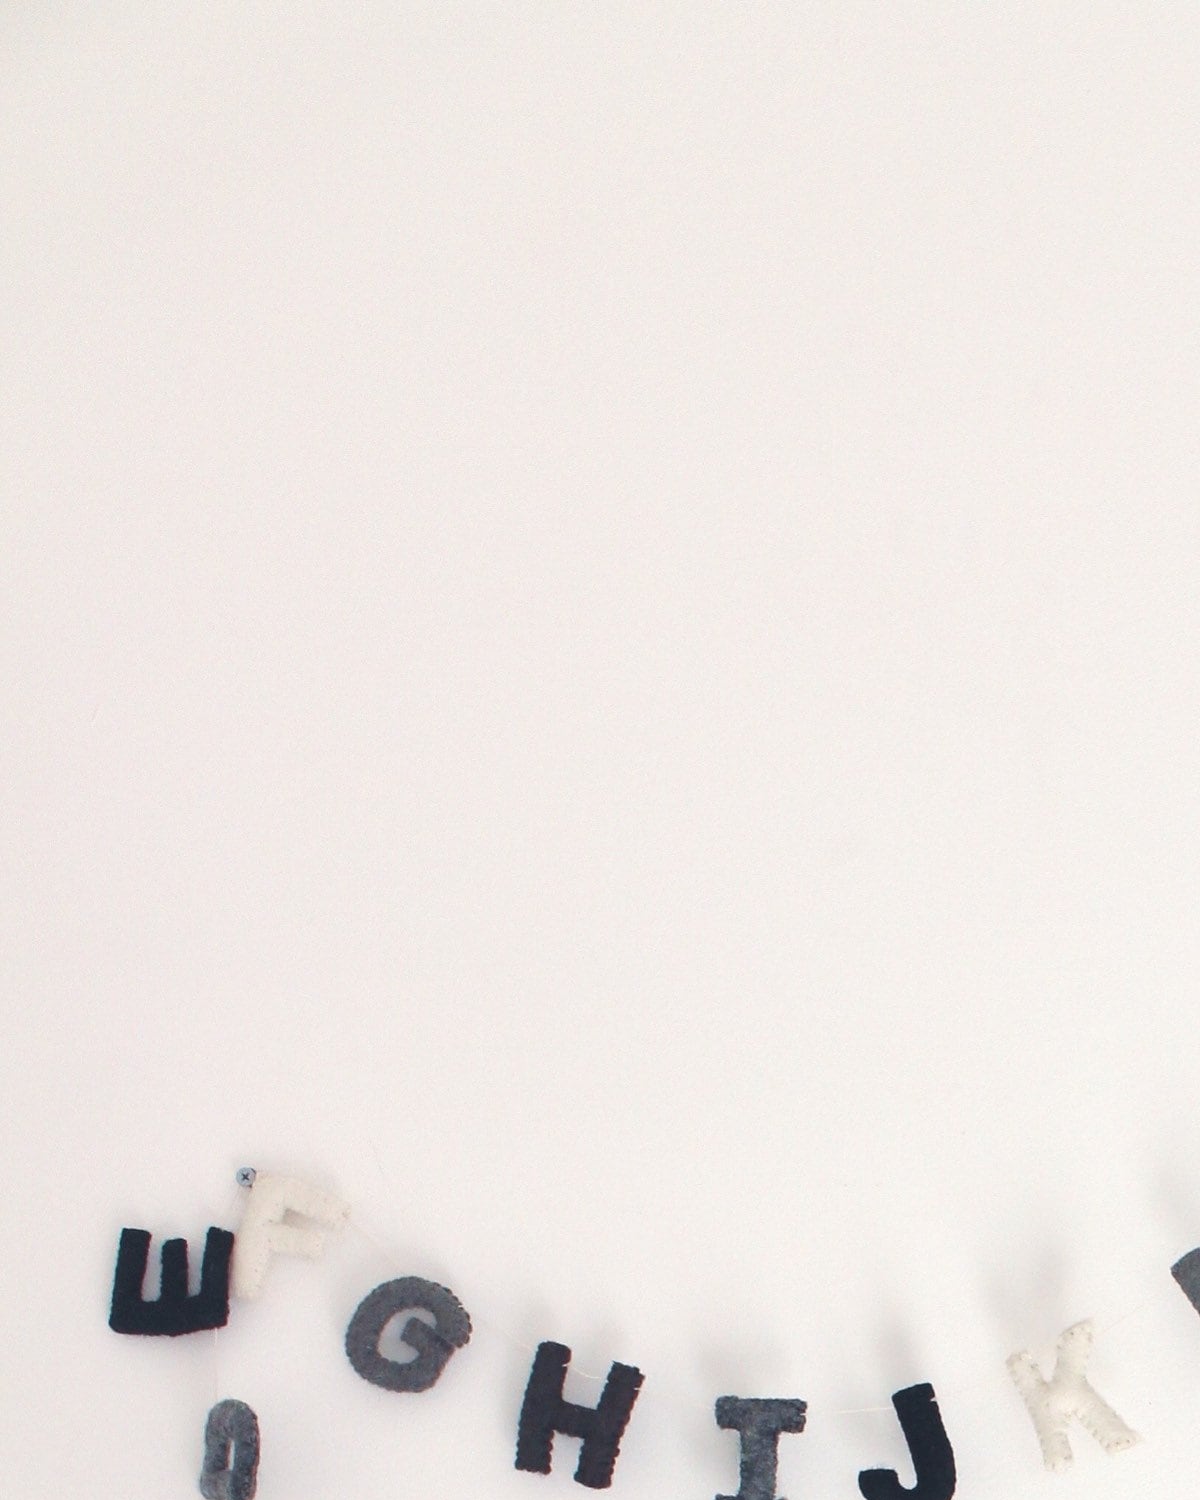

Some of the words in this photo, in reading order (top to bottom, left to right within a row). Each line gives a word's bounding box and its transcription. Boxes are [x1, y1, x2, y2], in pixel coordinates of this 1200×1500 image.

[109, 1226, 234, 1336] E
[234, 1170, 351, 1296] F
[345, 1276, 472, 1393] G
[514, 1341, 644, 1489] H
[1006, 1318, 1142, 1472] K
